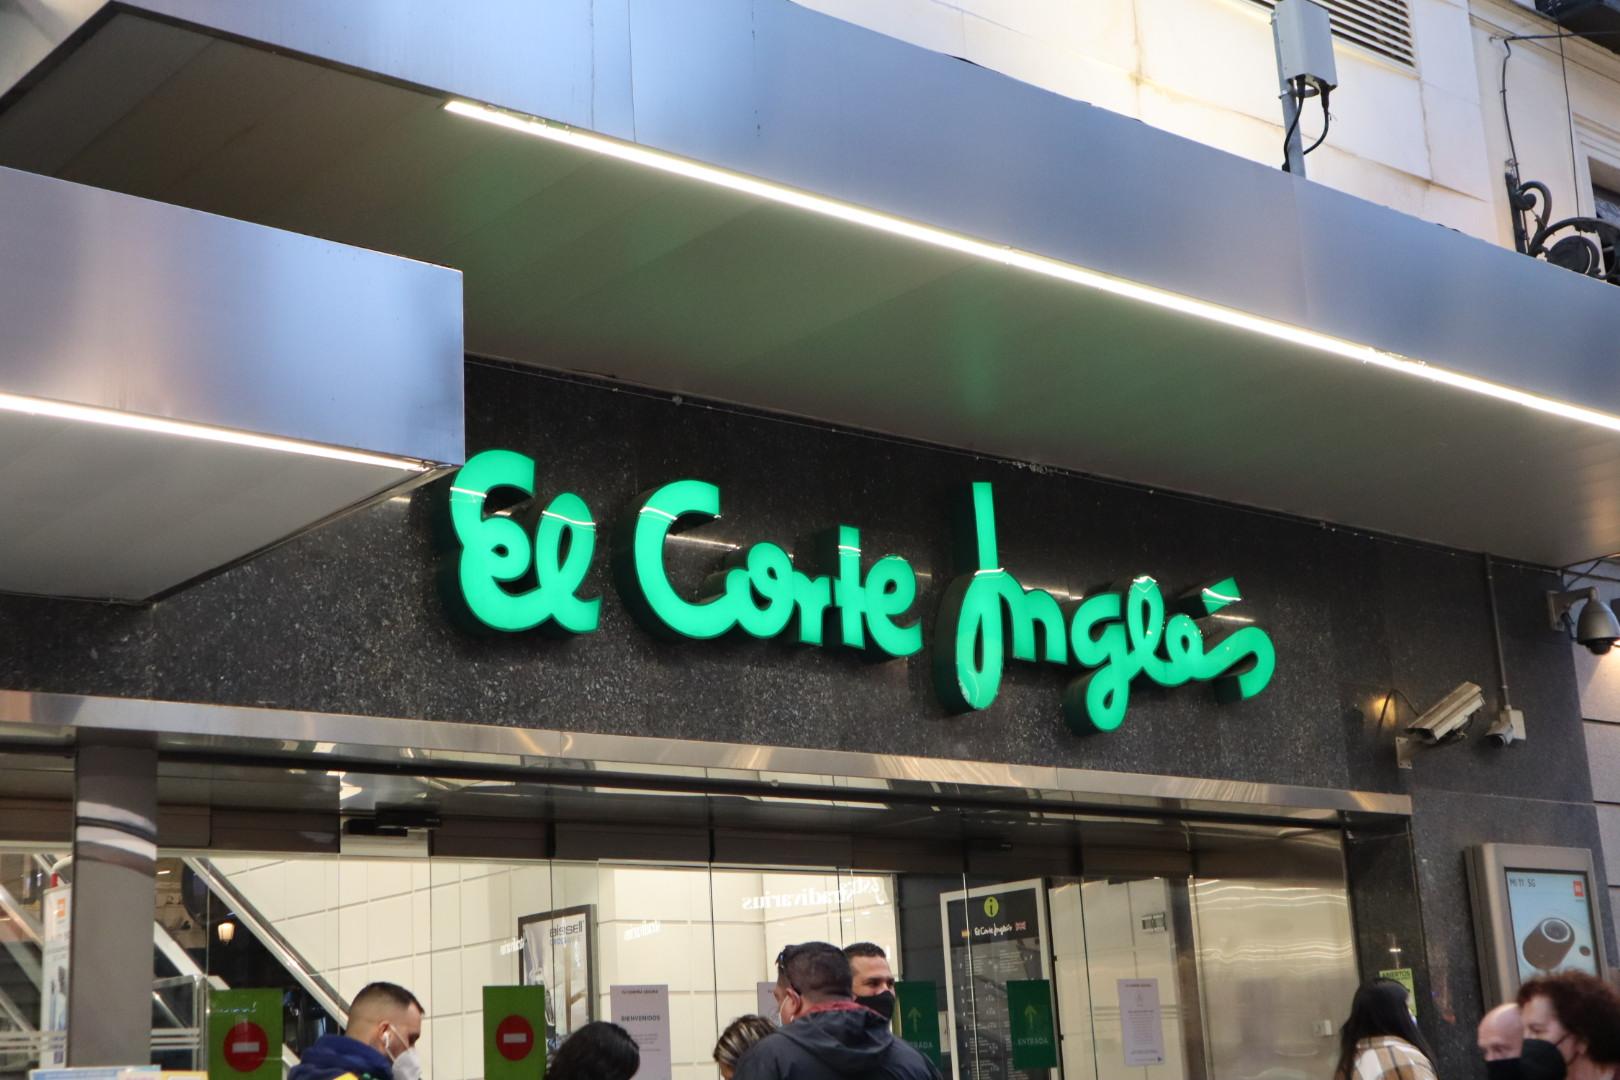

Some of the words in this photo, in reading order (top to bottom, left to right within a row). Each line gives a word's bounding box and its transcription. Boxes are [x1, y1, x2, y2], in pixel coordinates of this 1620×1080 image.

[450, 449, 600, 634] El
[634, 479, 922, 658] Corte
[953, 482, 1276, 731] Inglés
